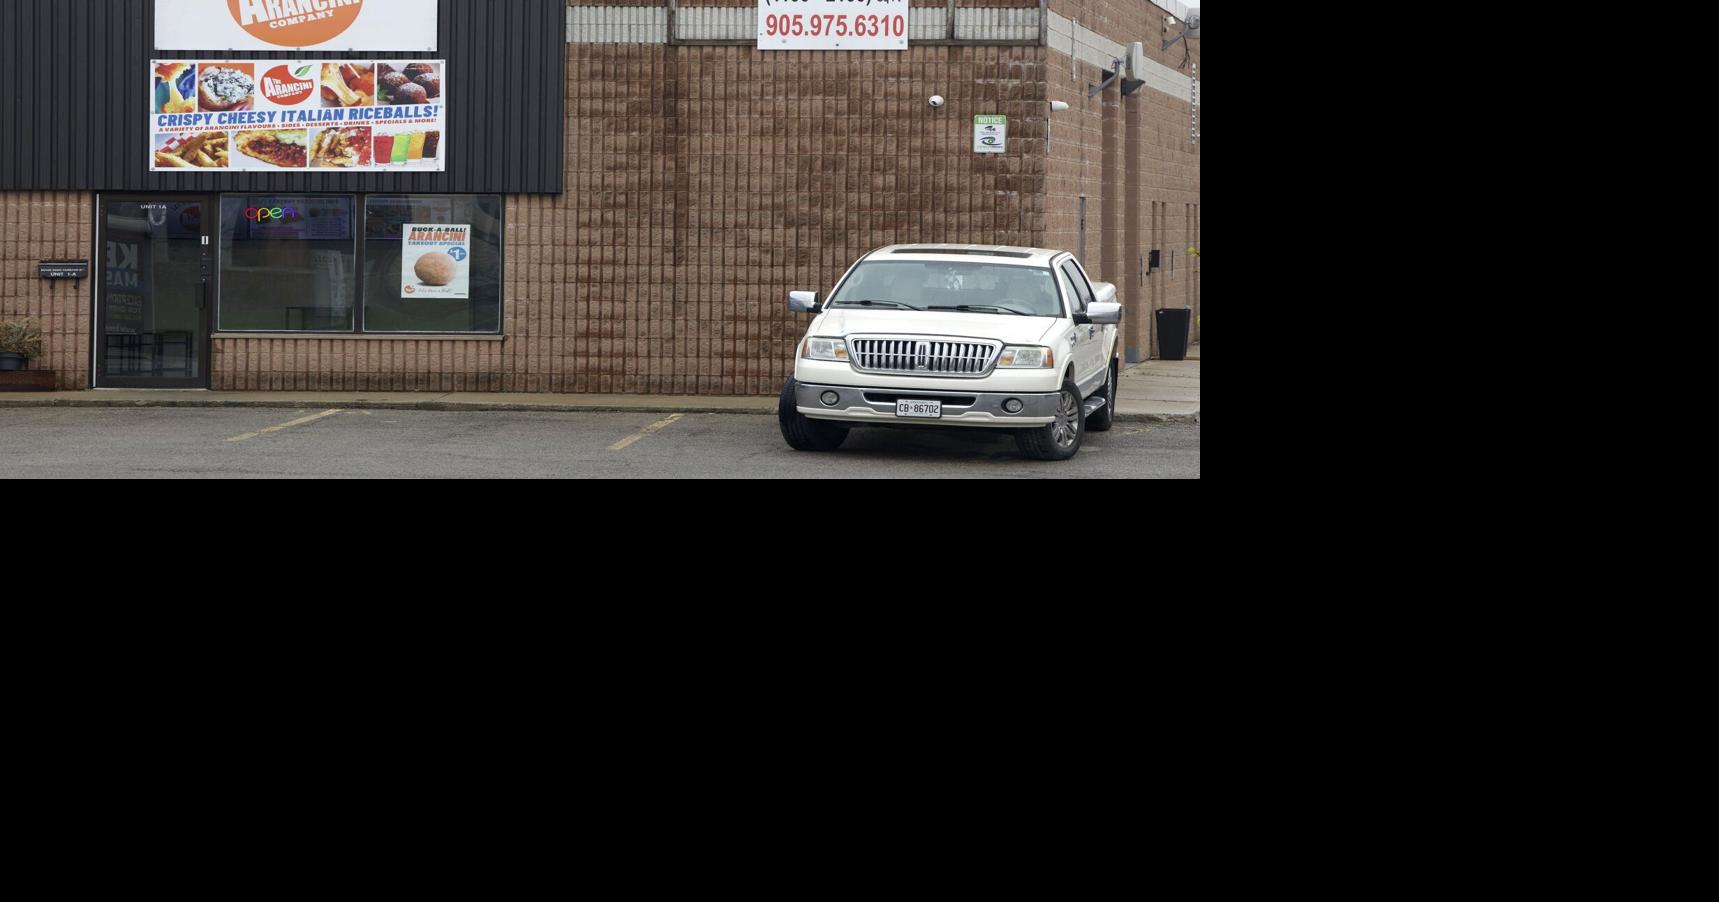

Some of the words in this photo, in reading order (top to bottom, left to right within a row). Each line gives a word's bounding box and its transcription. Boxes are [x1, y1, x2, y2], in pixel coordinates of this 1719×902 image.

[239, 0, 361, 26] ARANC
[269, 9, 334, 29] COMPANY
[766, 14, 905, 37] 905.975.6310
[263, 77, 313, 98] ARANCINI
[157, 113, 213, 127] CRISPY
[217, 110, 277, 125] CHEESY
[281, 108, 344, 123] ITALIAN
[349, 105, 439, 120] RICEBALLS!
[978, 116, 1003, 124] NOTICE
[408, 231, 466, 241] ARANCINI
